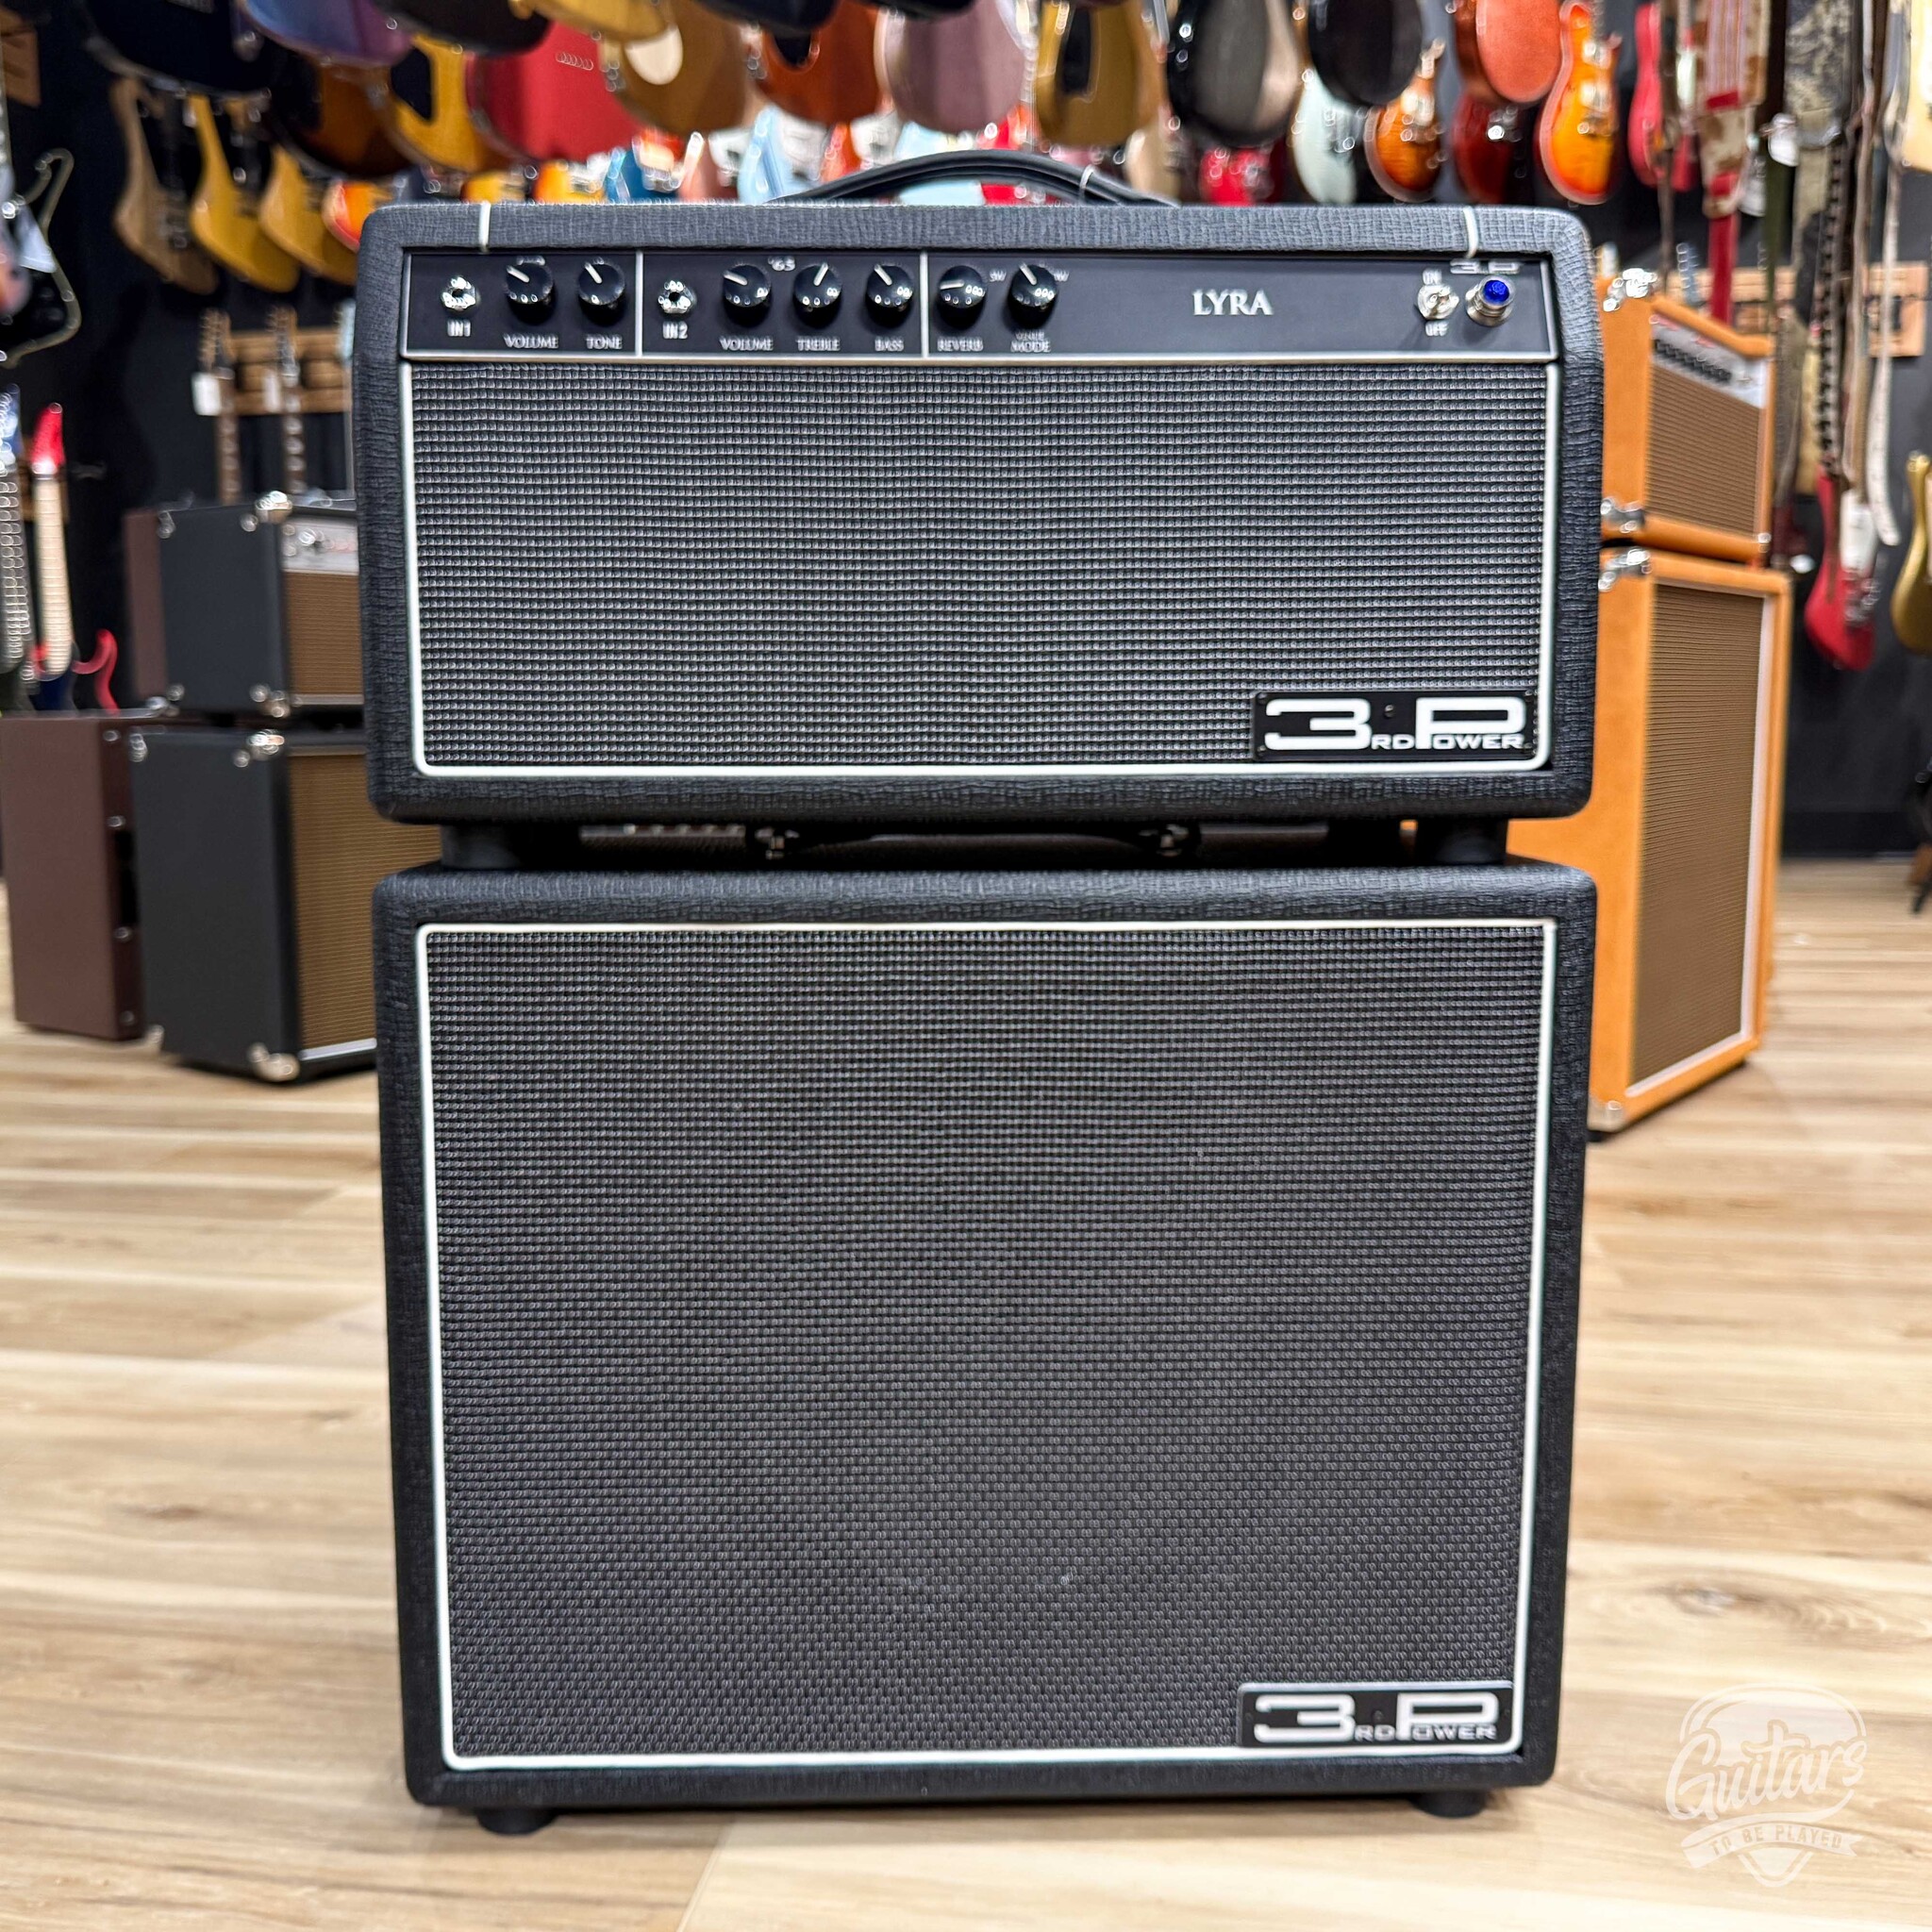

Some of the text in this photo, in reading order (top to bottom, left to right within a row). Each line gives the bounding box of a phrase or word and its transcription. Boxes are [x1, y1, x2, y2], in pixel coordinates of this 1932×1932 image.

[1423, 269, 1442, 284] ON
[1192, 289, 1272, 316] LYRA
[1425, 321, 1449, 336] OFF
[504, 336, 559, 349] VOLUME
[586, 337, 623, 350] TONE
[721, 337, 774, 351] VOLUME
[797, 337, 841, 352] TREBLE
[874, 338, 904, 352] BASS
[938, 338, 984, 352] REVERB
[1010, 340, 1051, 353] MODE
